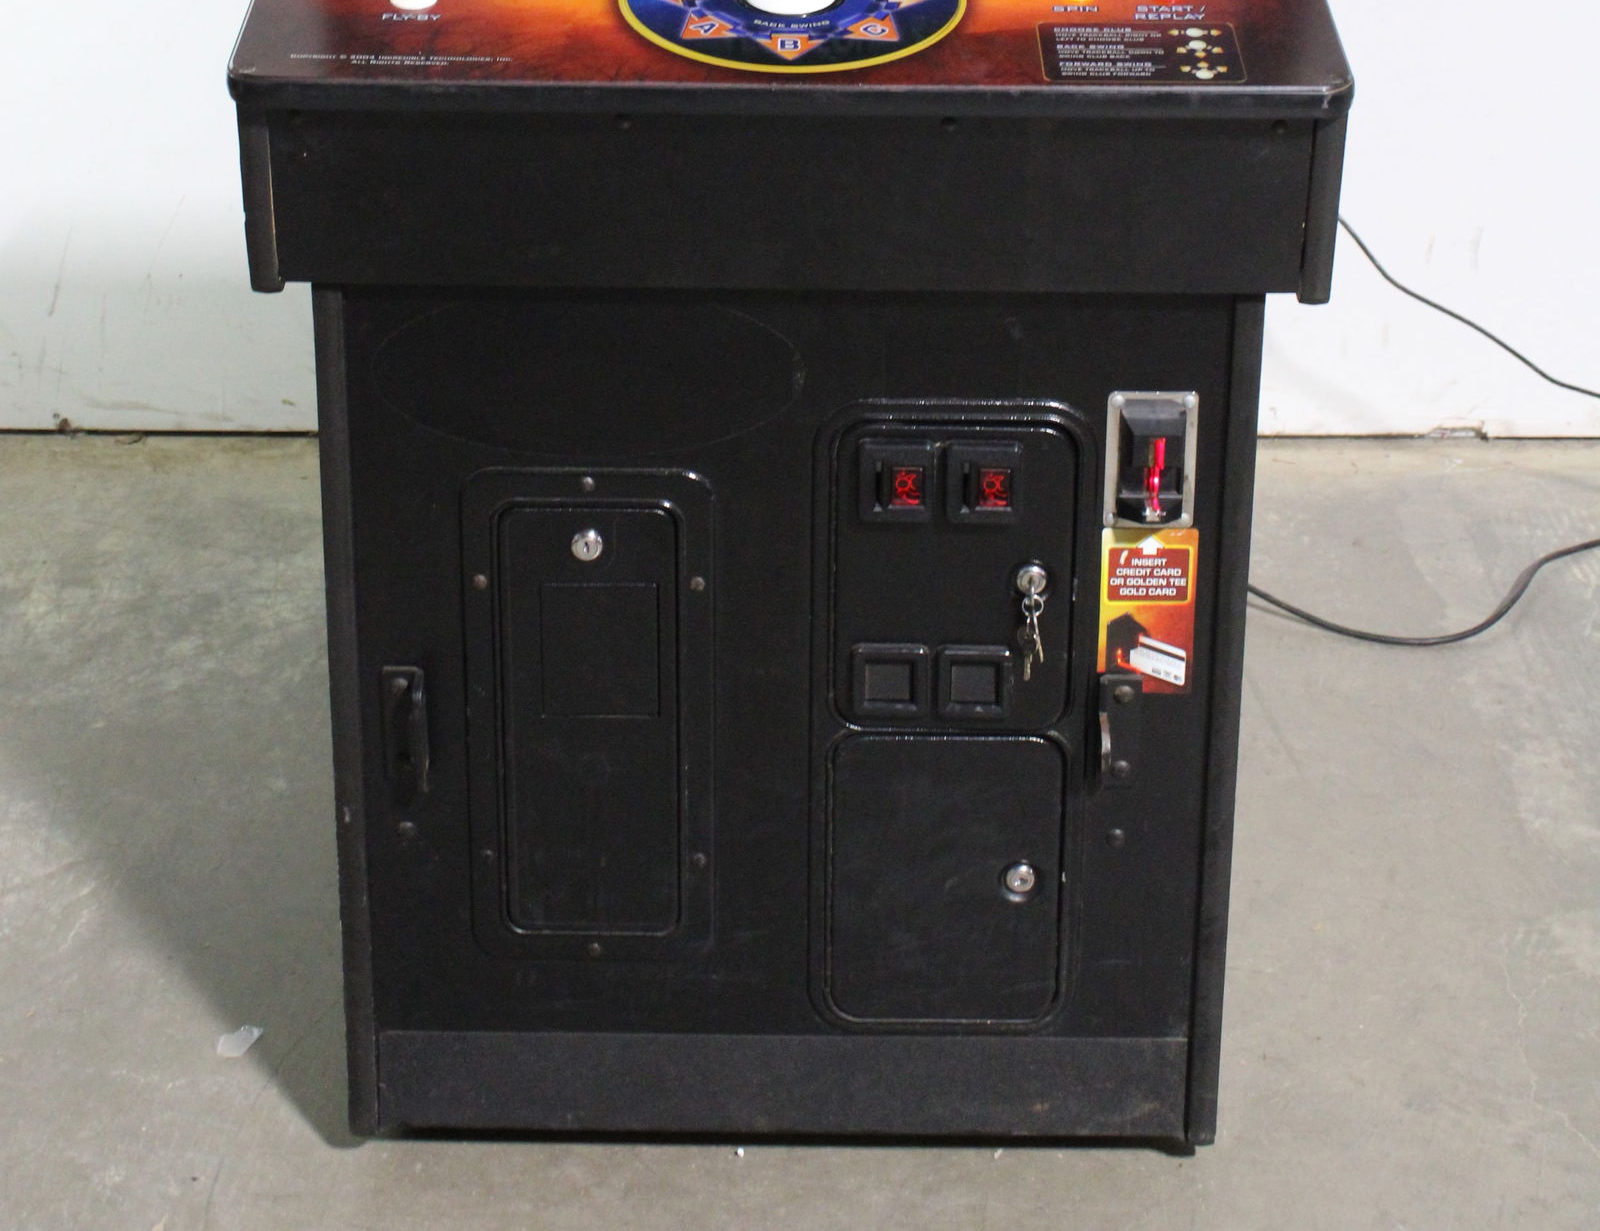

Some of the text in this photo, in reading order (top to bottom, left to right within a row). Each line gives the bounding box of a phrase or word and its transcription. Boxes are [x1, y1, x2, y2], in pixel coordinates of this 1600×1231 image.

[1136, 5, 1194, 13] START
[381, 13, 442, 21] FLY-BY
[1135, 13, 1206, 21] REPLAY
[753, 18, 831, 29] BACK SWING
[777, 38, 801, 51] B
[1131, 557, 1168, 567] INSERT
[1116, 567, 1182, 577] CREDIT CARD
[1109, 577, 1187, 587] OR GOLDEN TEE
[1119, 587, 1177, 596] GOLD CARD
